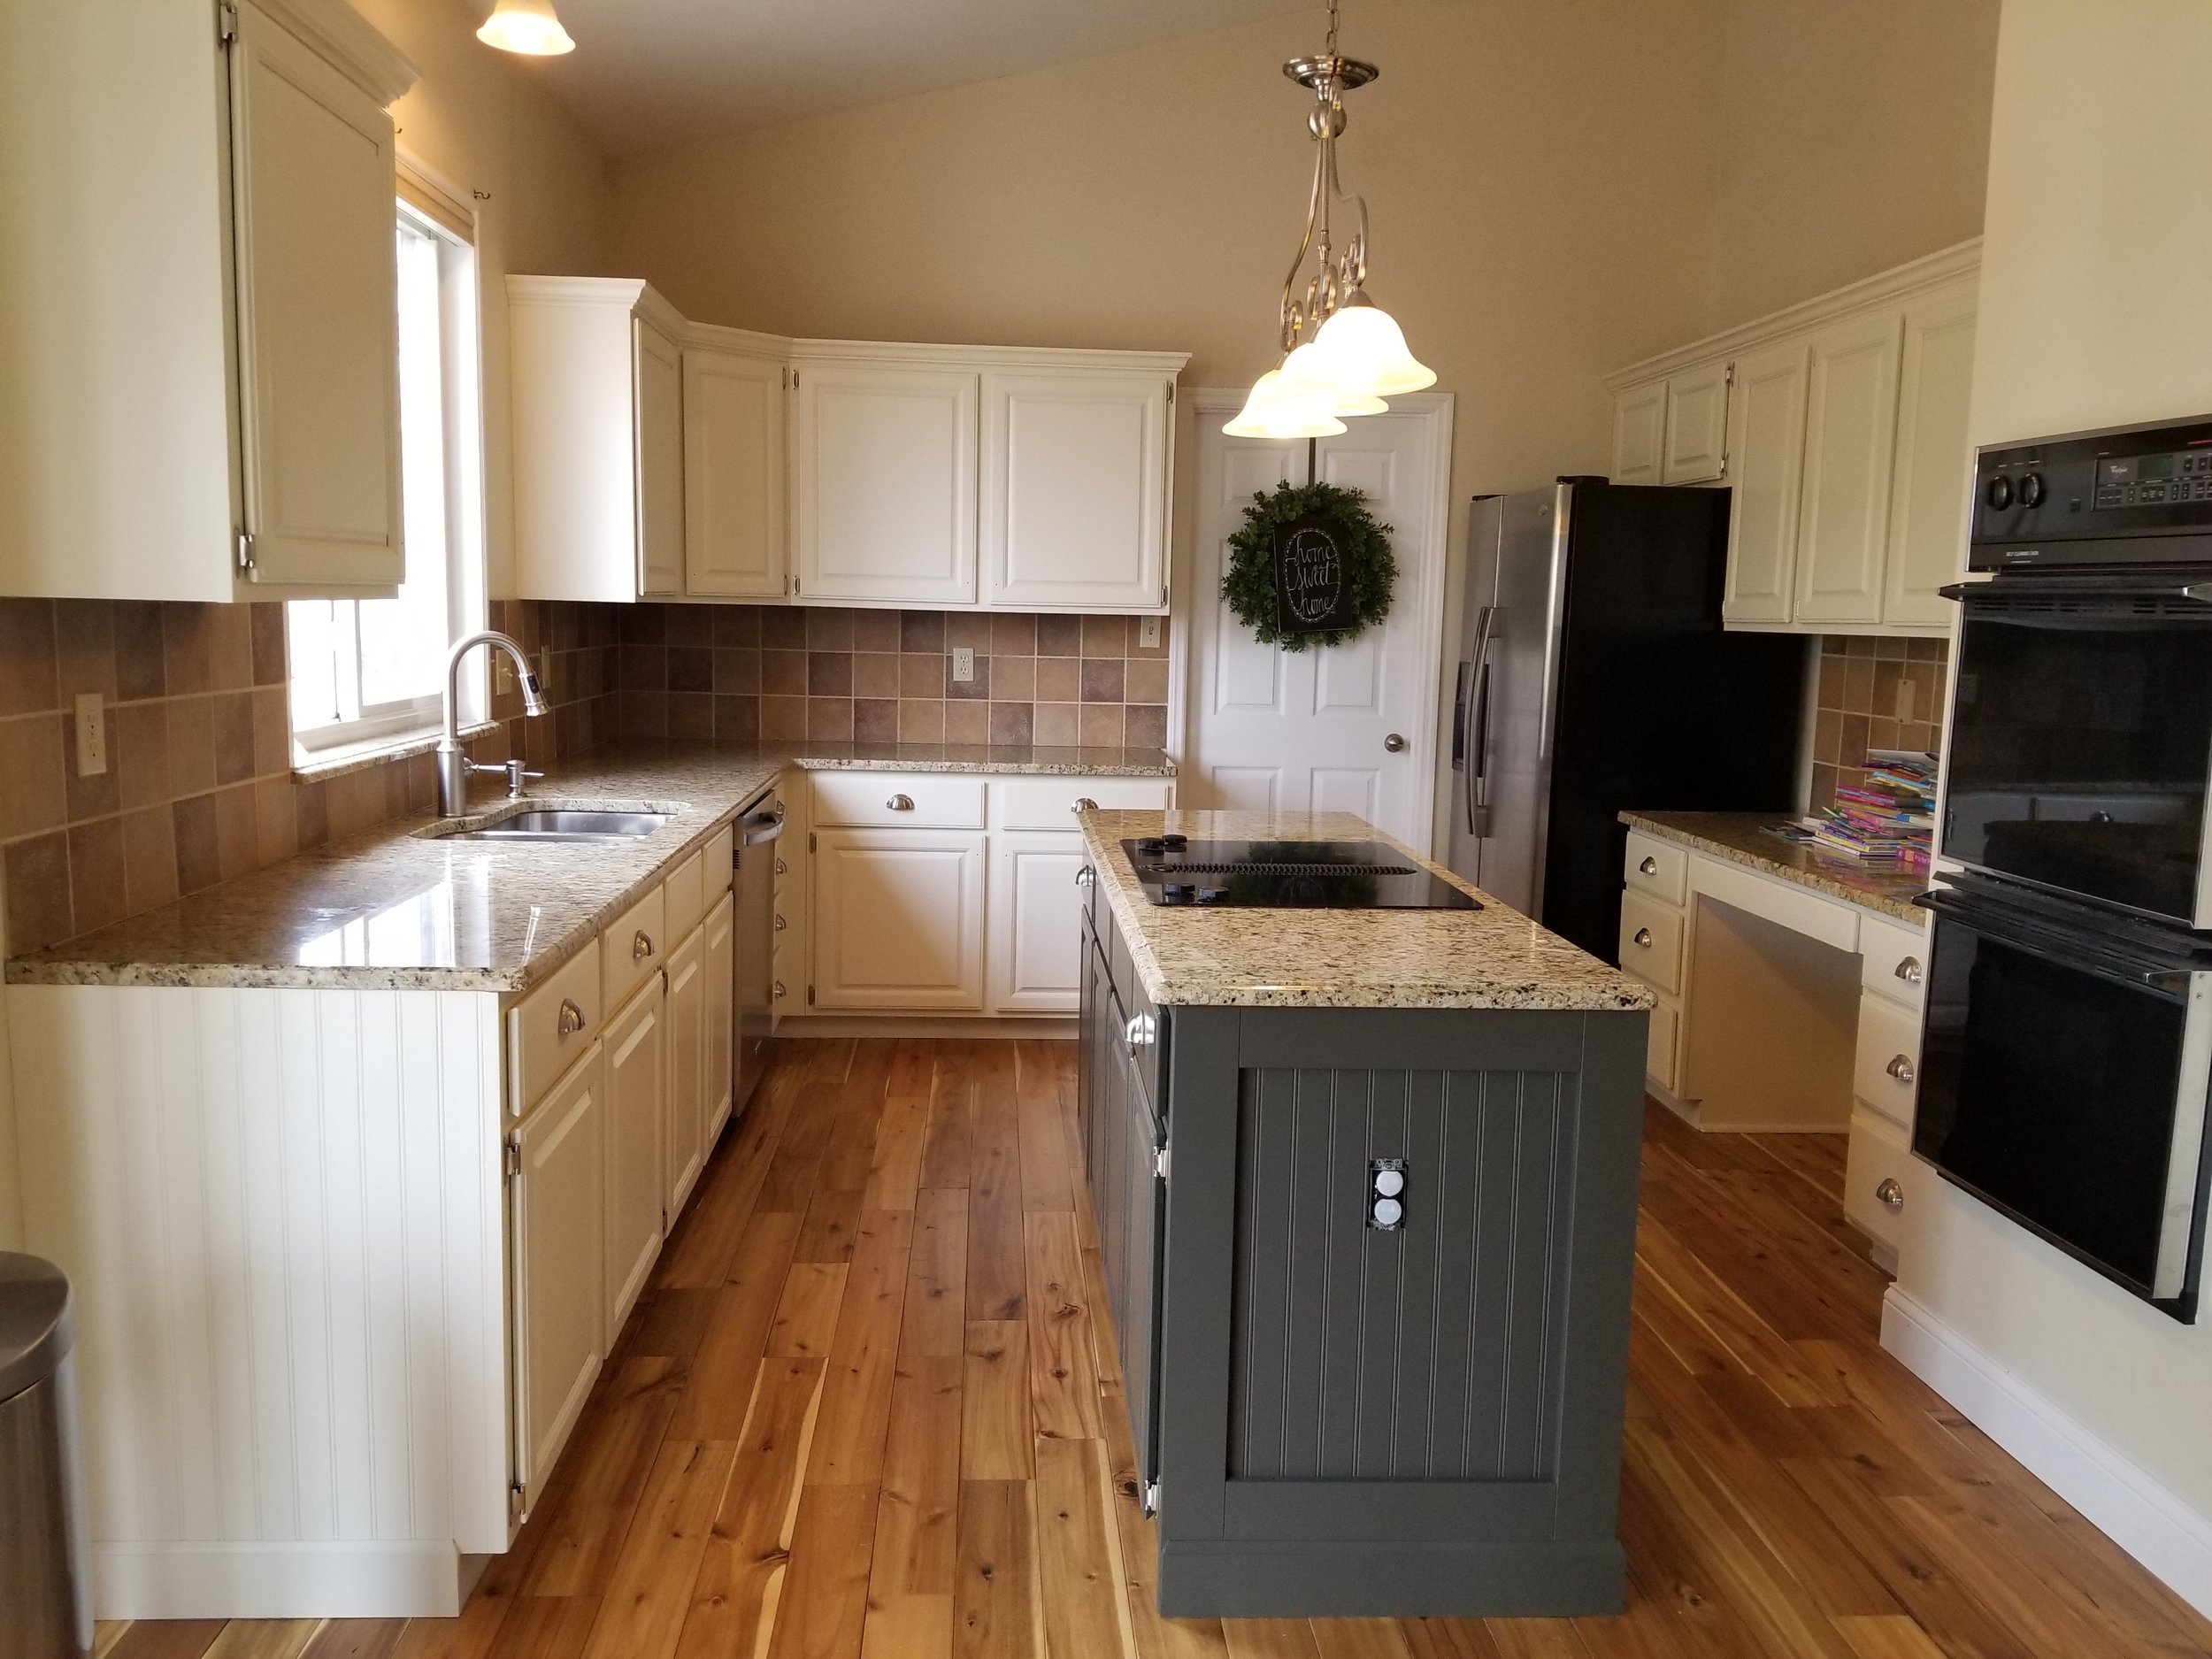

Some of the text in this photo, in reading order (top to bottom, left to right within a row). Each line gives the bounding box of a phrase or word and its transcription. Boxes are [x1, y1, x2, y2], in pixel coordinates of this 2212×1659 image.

[1289, 535, 1336, 566] home
[1291, 561, 1336, 590] sweet
[1297, 588, 1333, 617] home
